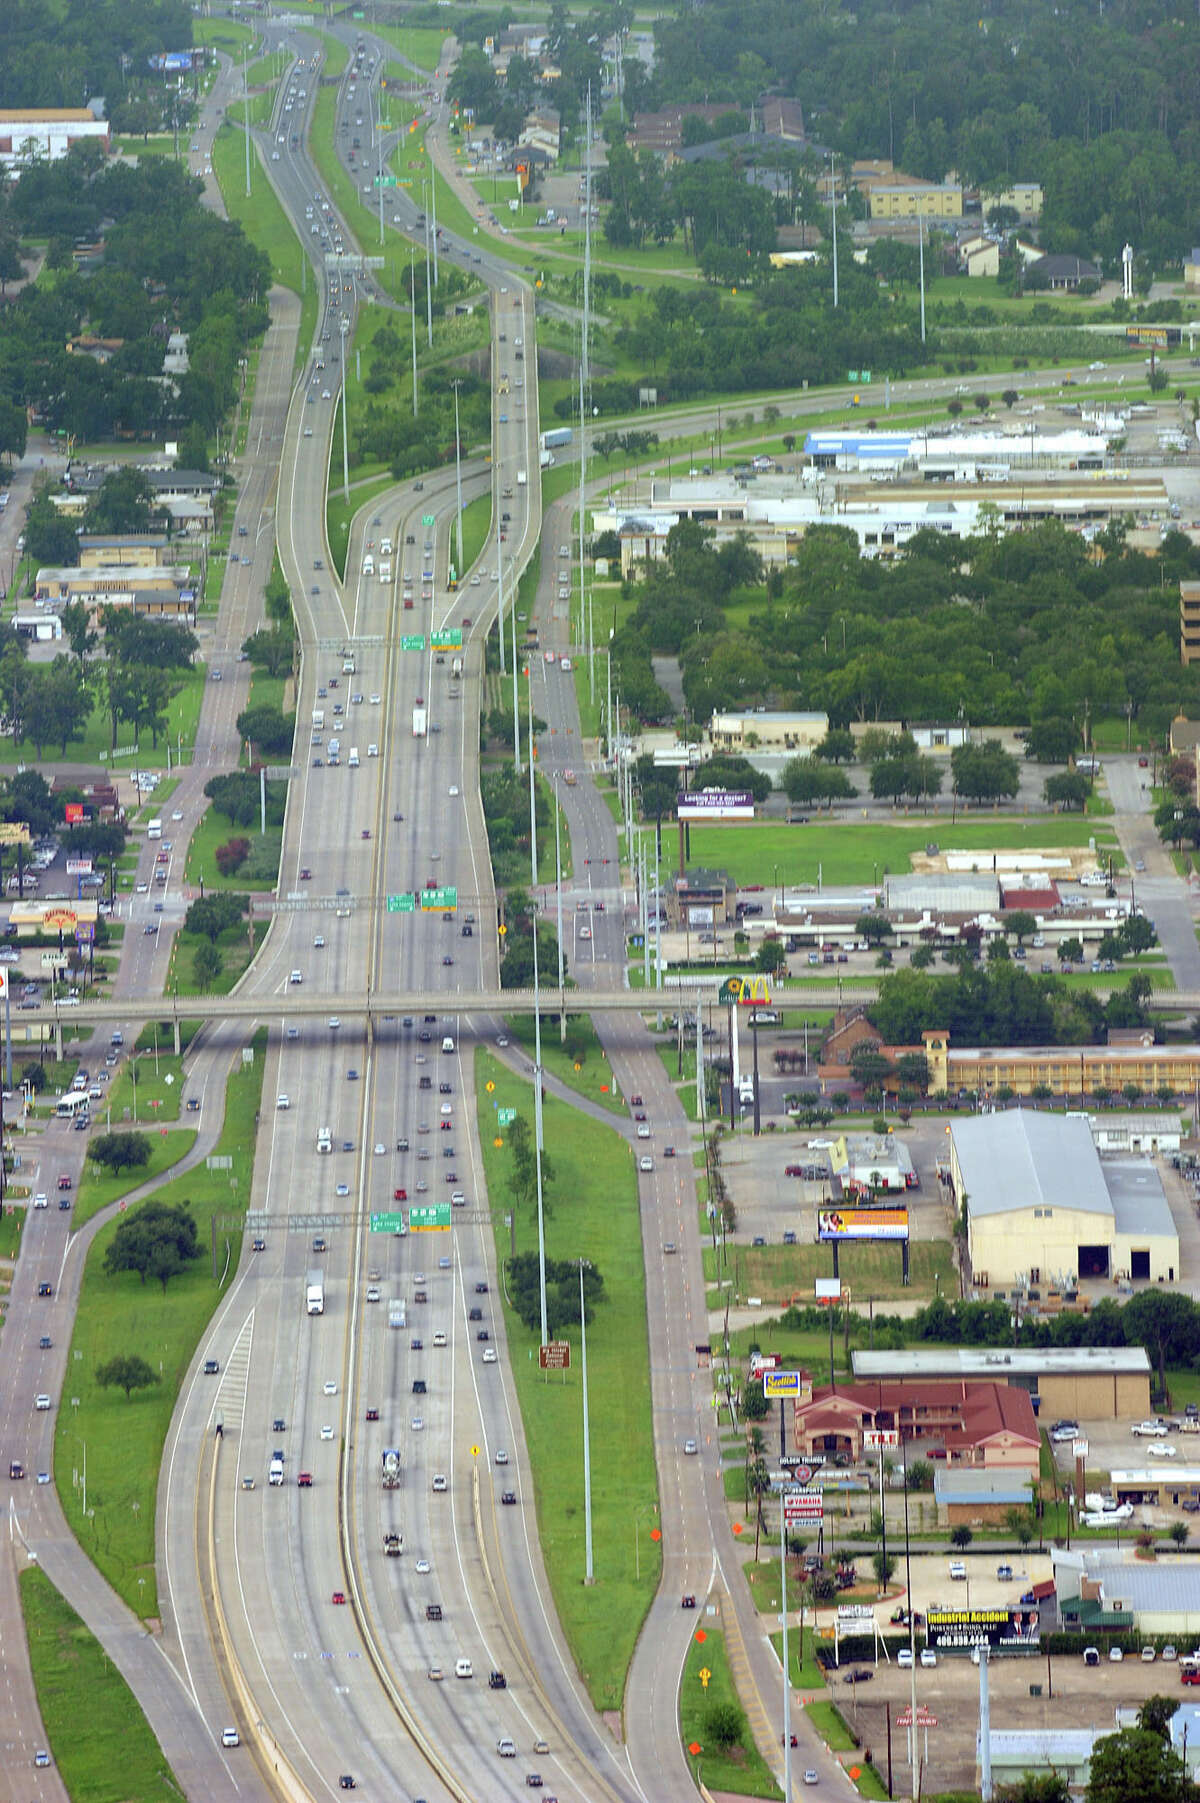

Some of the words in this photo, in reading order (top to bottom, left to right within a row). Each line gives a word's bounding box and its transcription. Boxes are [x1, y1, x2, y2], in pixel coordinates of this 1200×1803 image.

[768, 1375, 797, 1387] Scottish
[871, 1434, 897, 1444] TILE
[786, 1508, 822, 1517] Kawasaki
[928, 1611, 970, 1624] Industrial
[970, 1611, 1008, 1623] Accident
